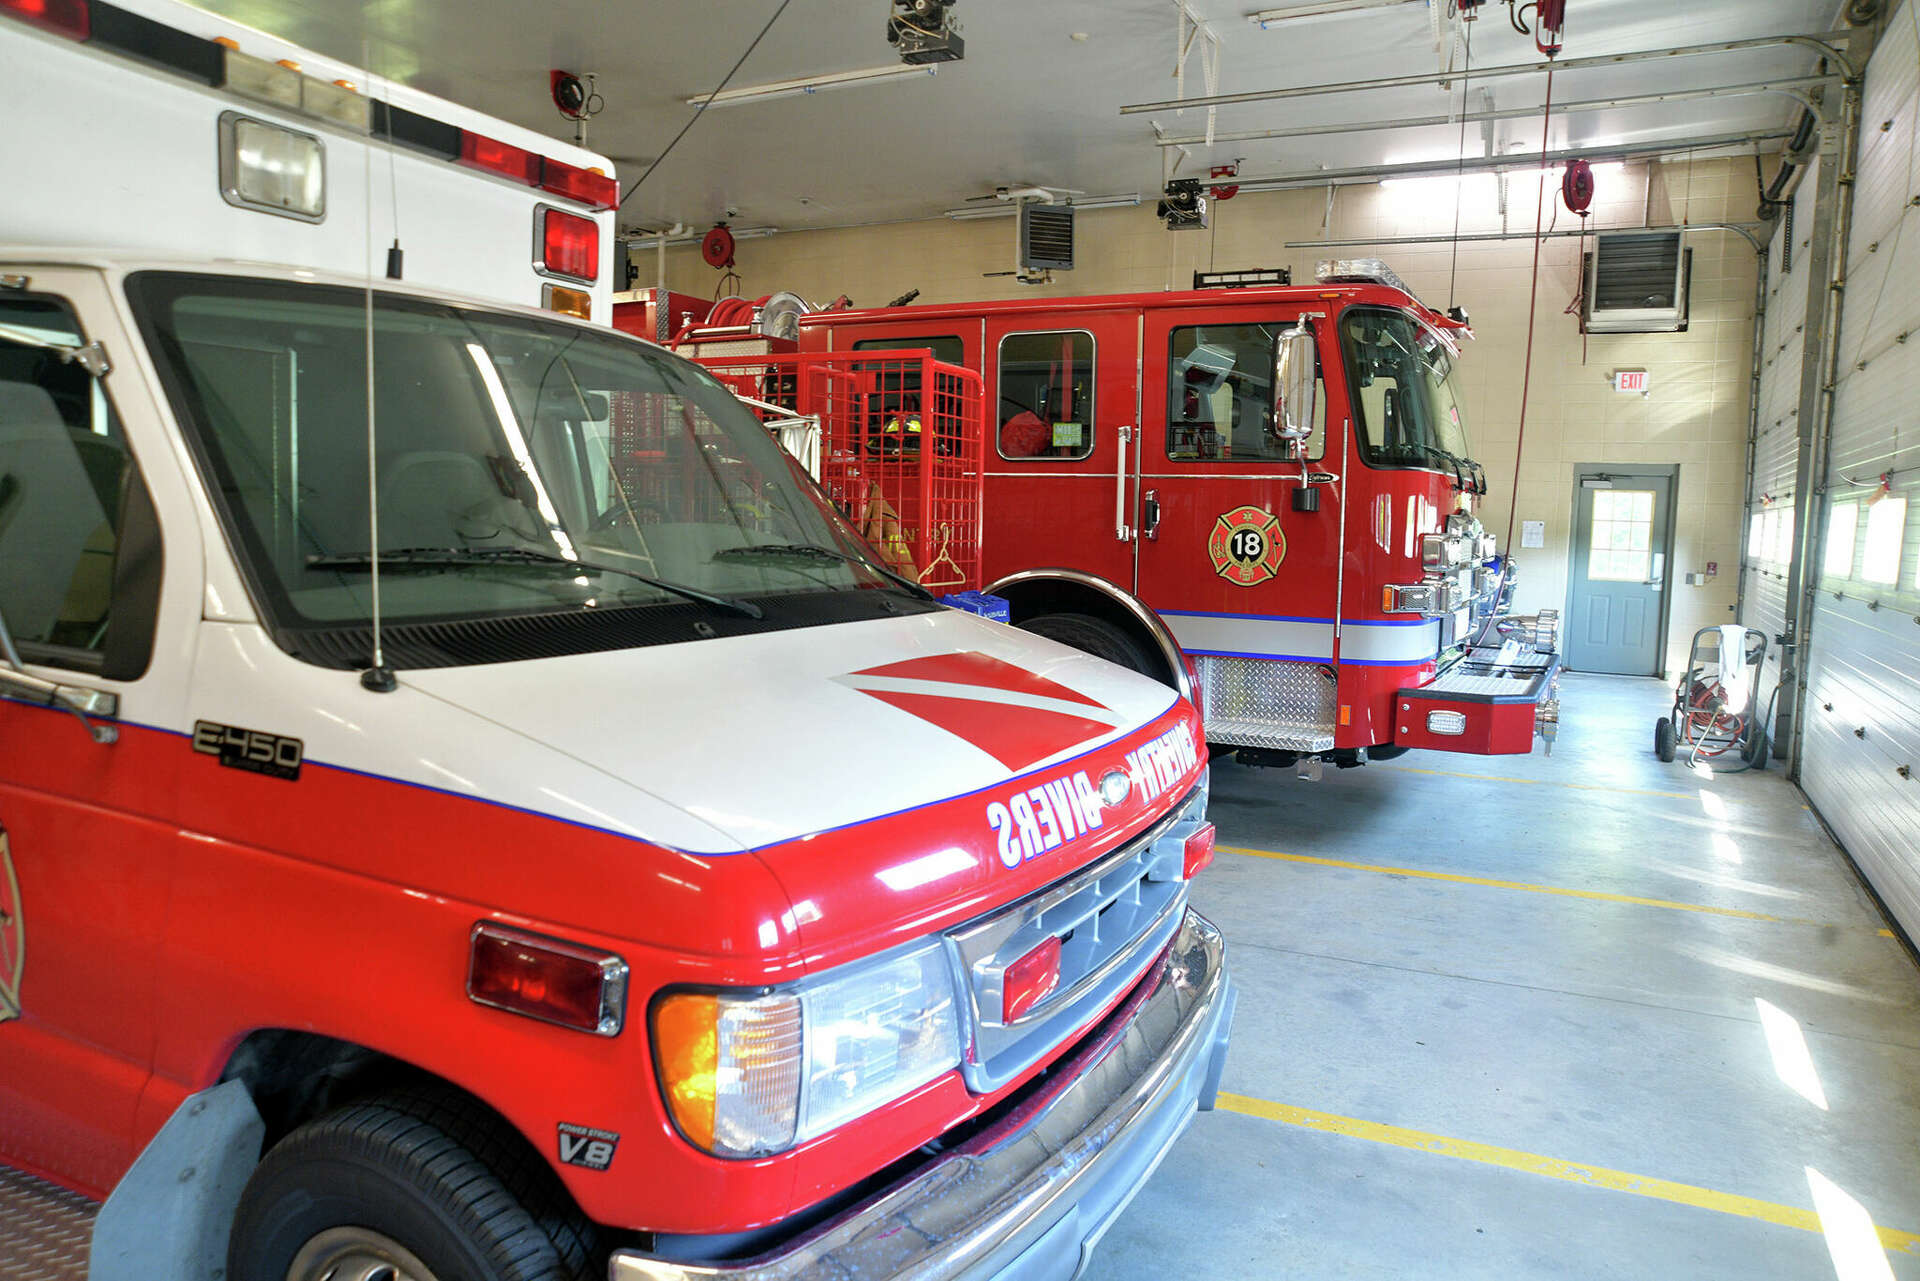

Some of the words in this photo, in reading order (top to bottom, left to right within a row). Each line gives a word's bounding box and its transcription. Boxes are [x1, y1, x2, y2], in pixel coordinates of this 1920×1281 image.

[1621, 373, 1644, 389] EXIT
[1234, 533, 1260, 555] 18
[559, 1133, 614, 1165] V8
